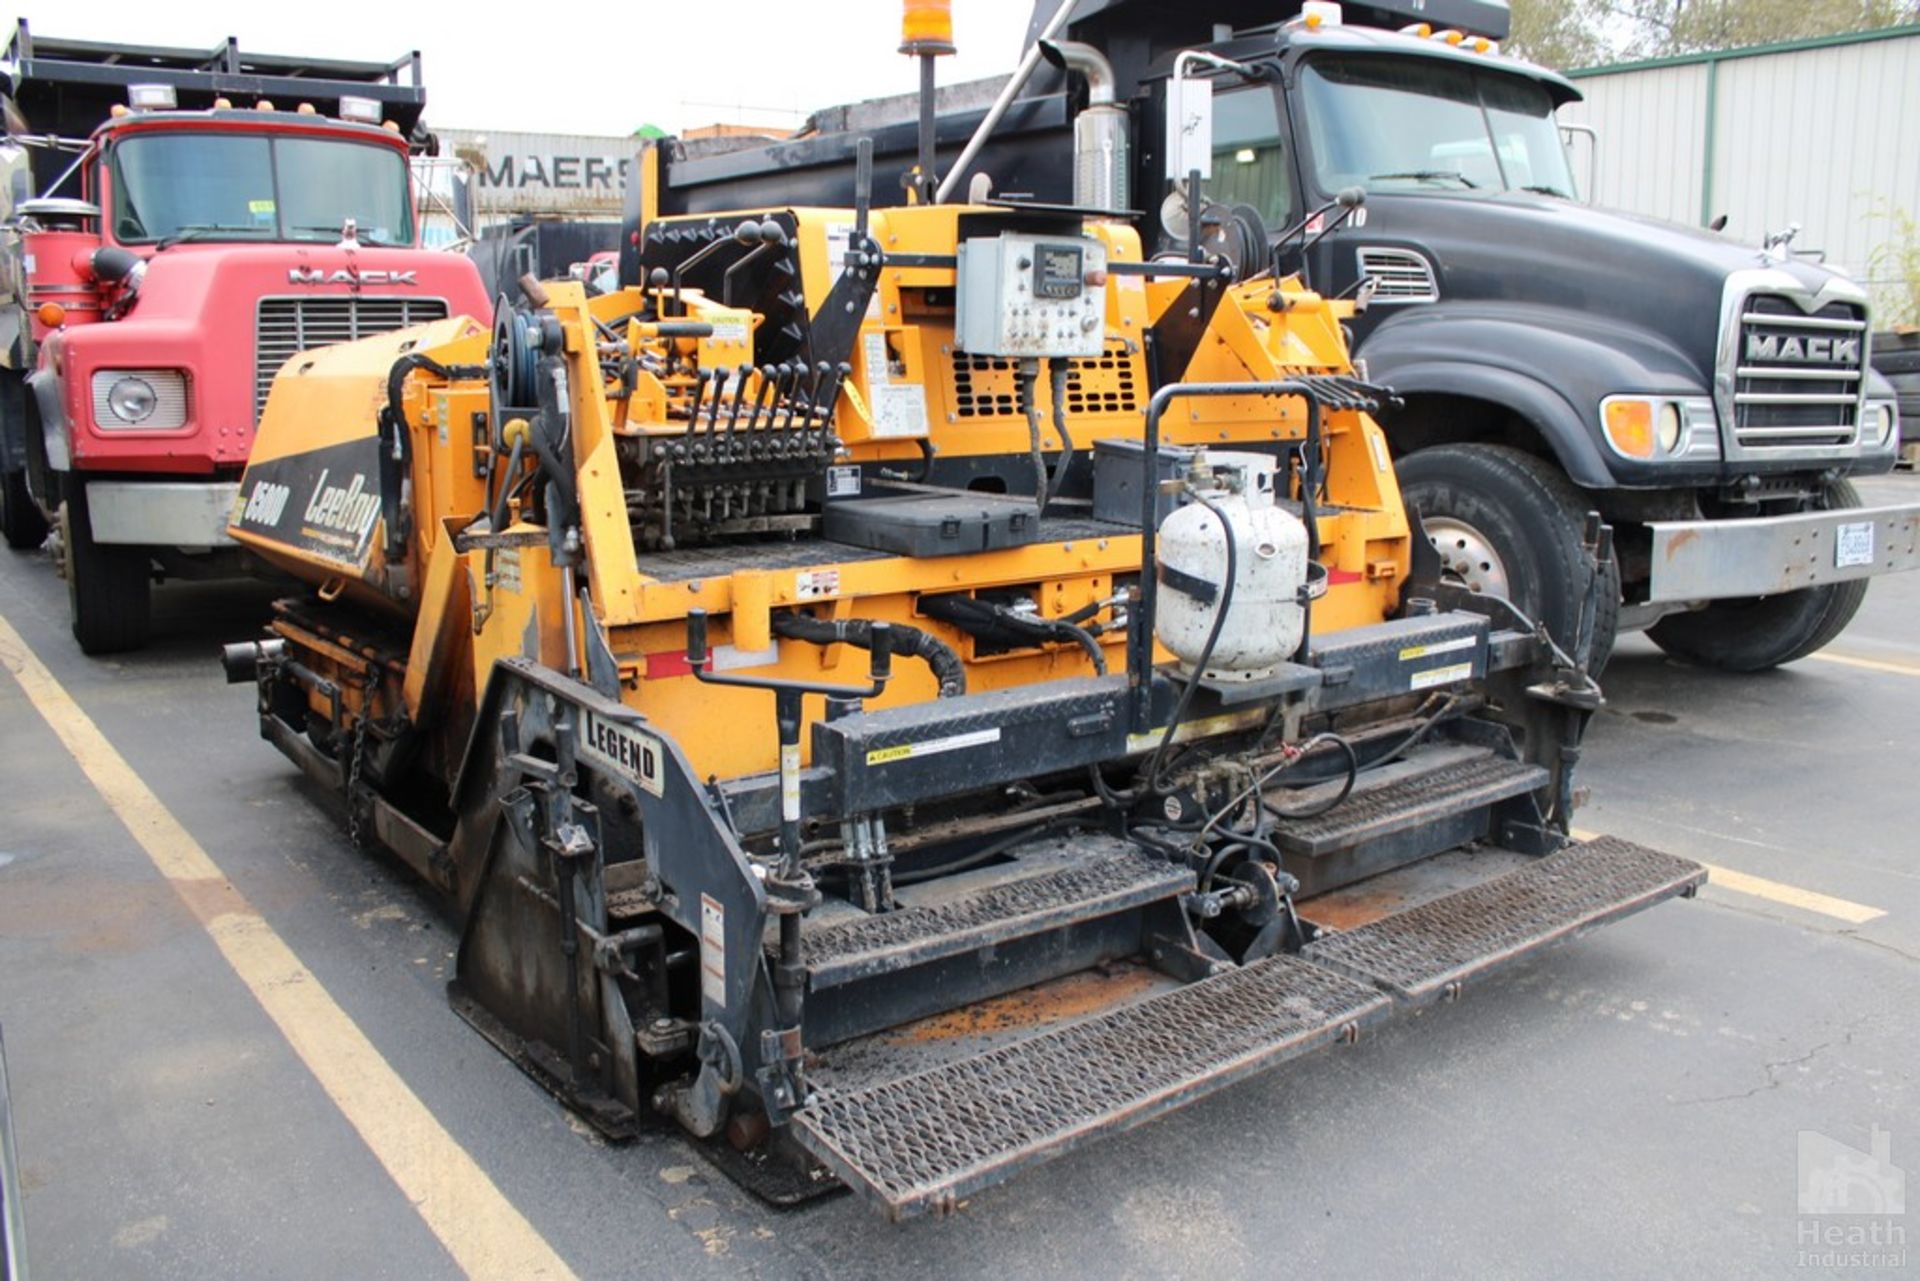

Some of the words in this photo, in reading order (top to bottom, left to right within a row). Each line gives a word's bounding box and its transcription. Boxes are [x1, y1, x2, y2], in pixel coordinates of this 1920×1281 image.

[1347, 207, 1367, 228] 10
[288, 269, 418, 286] MACK
[1745, 334, 1860, 362] MACK
[304, 467, 382, 557] LeeBoy
[586, 709, 655, 780] LEGEND
[877, 747, 912, 761] CAUTION
